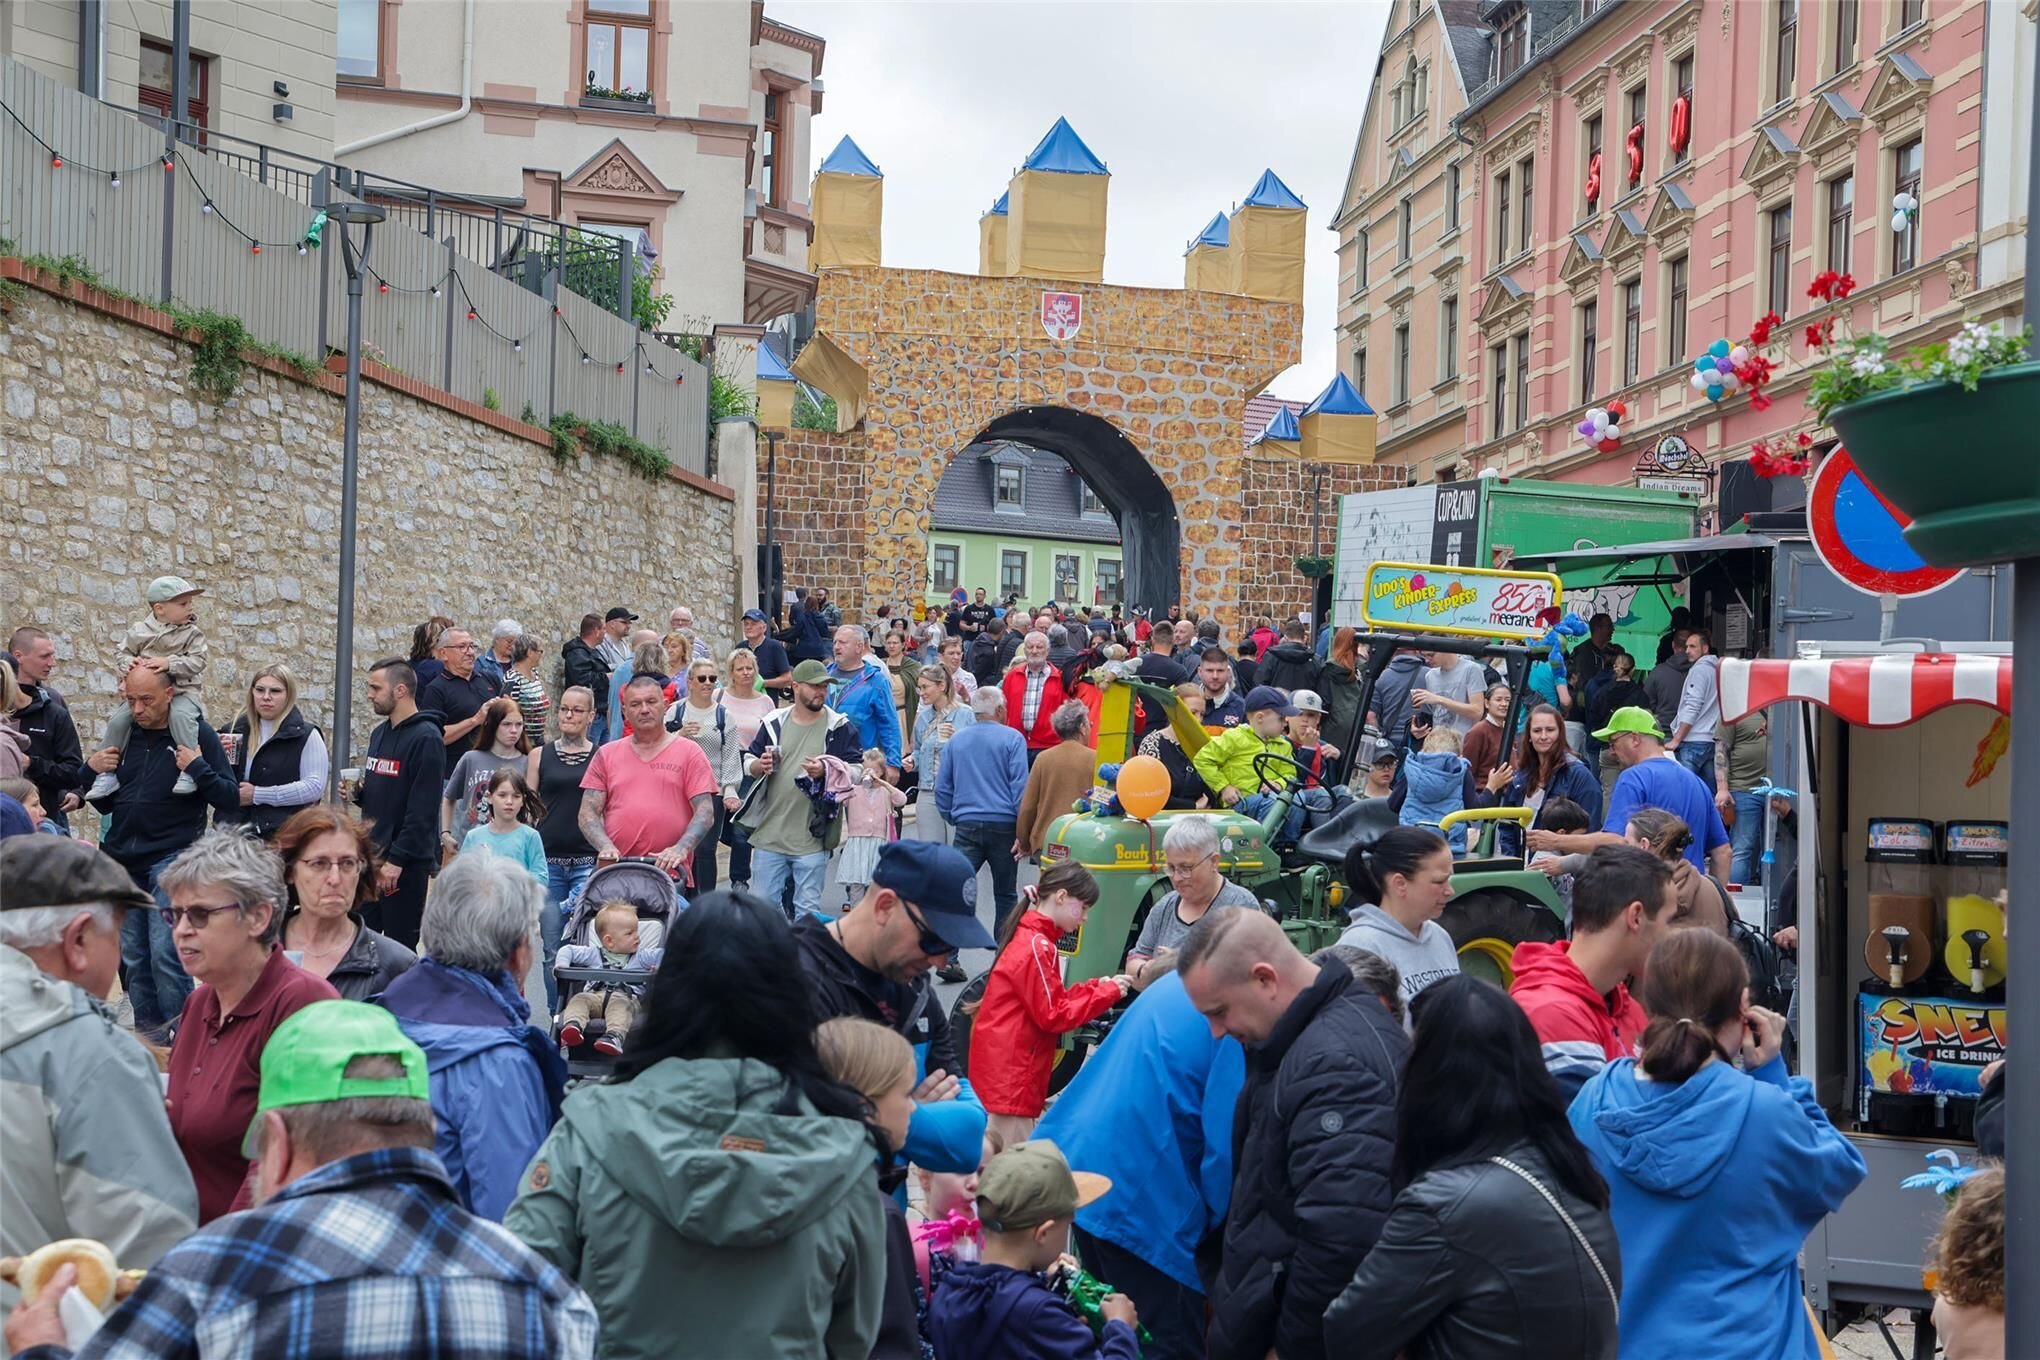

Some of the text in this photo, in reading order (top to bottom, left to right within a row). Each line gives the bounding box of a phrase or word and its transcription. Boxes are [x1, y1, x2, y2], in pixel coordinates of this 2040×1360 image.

[1394, 584, 1440, 610] KINDER-
[1428, 588, 1477, 616] EXPRESS
[1936, 1049, 1955, 1059] ICE
